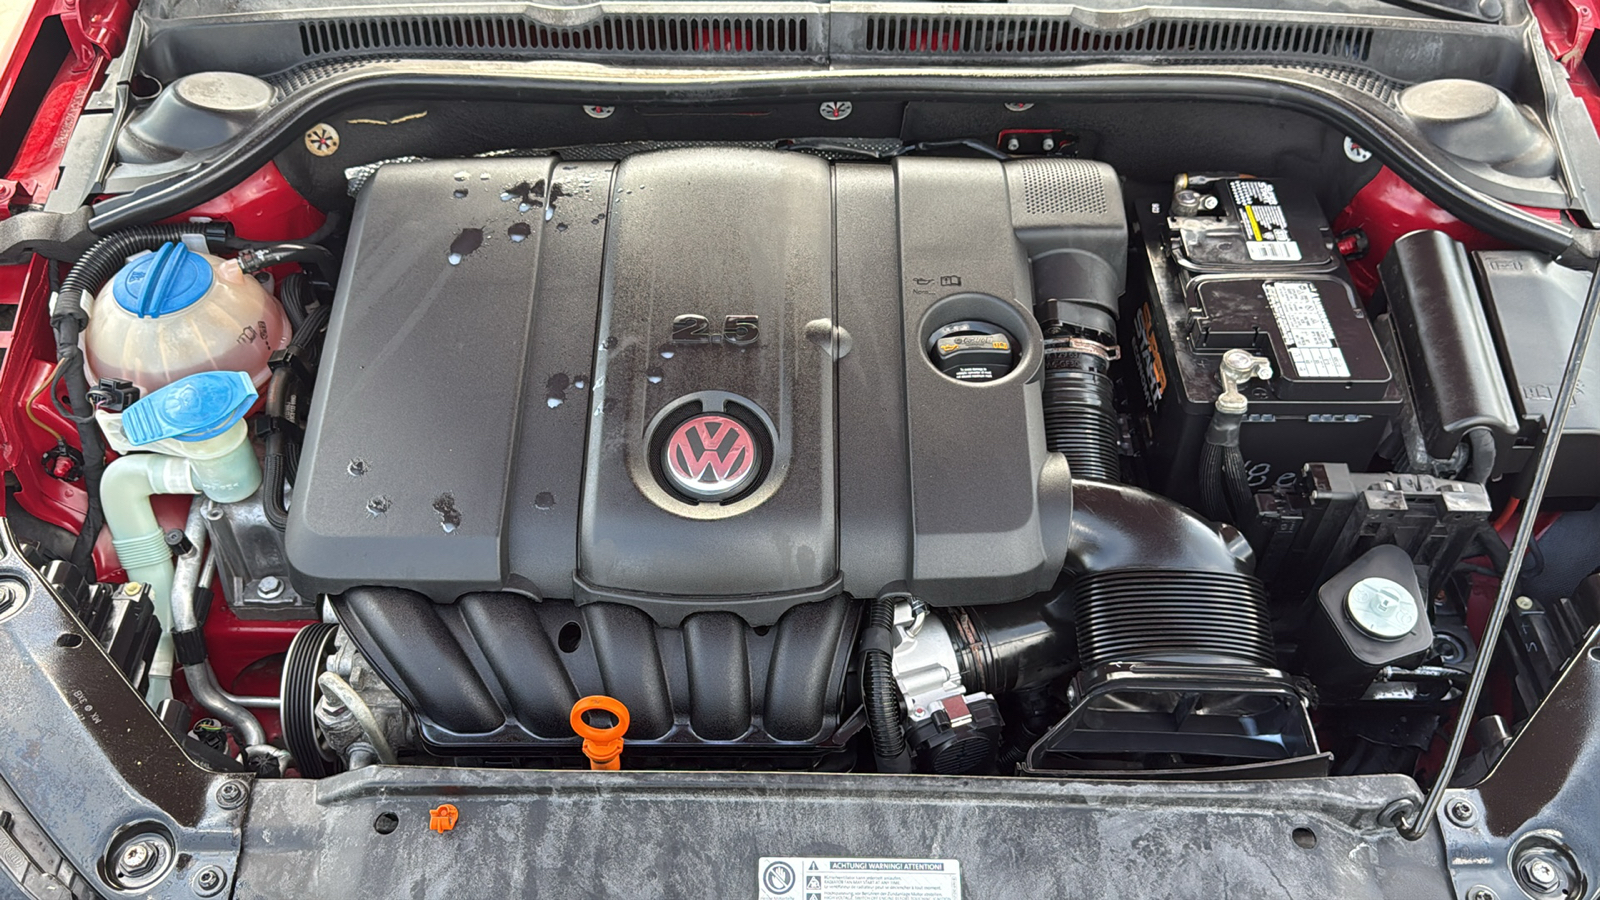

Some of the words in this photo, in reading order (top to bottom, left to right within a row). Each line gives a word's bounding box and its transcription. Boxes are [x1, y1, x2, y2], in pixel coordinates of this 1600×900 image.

[672, 313, 759, 345] 2.5
[1134, 307, 1162, 402] START
[1142, 301, 1167, 395] SUPER
[1132, 336, 1152, 407] ECONOMY
[668, 415, 755, 495] VW
